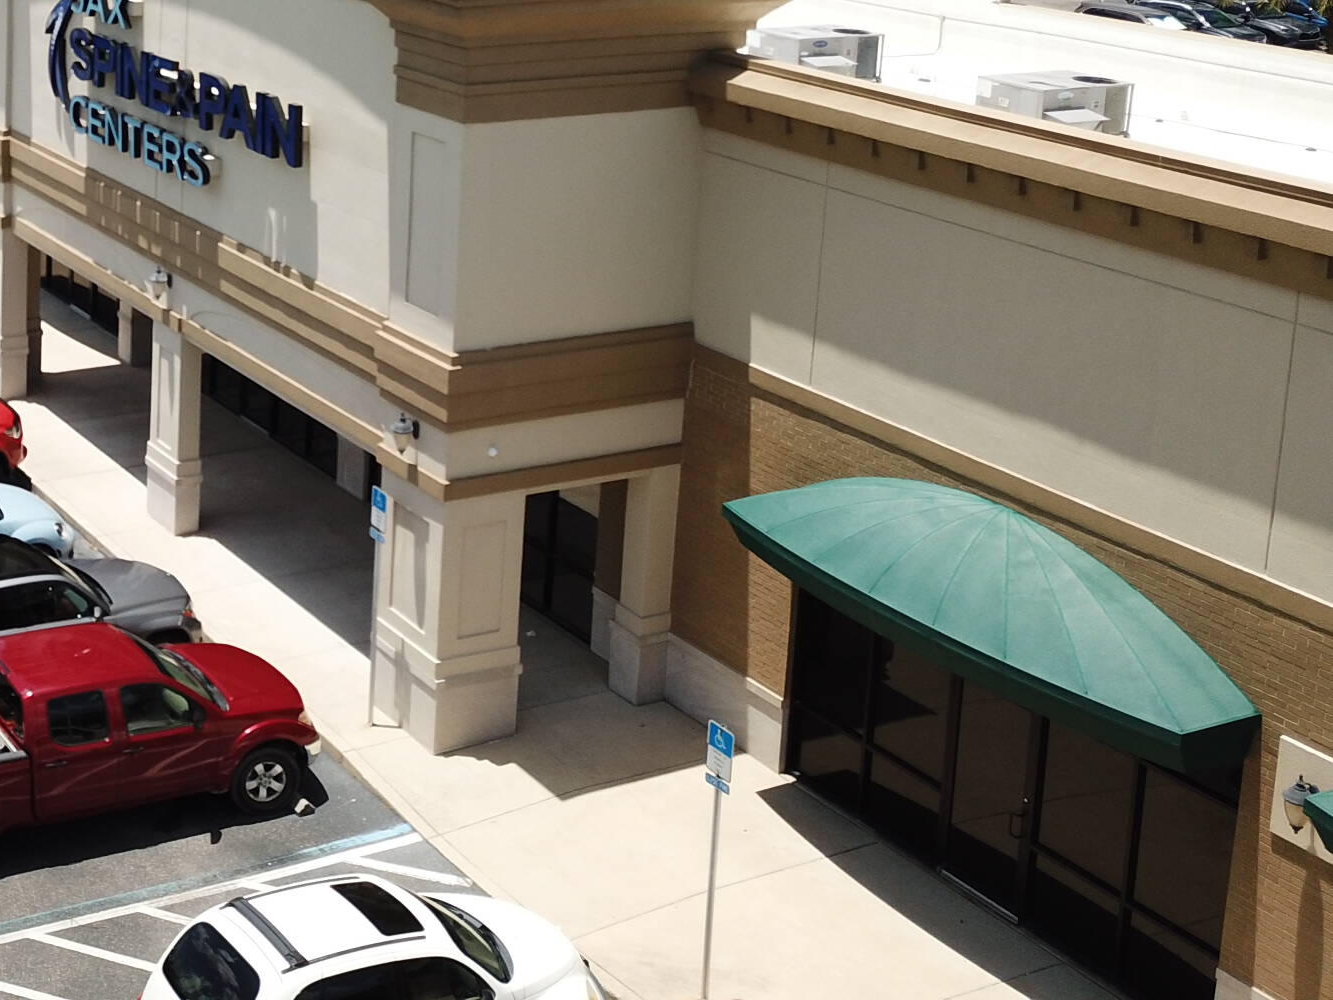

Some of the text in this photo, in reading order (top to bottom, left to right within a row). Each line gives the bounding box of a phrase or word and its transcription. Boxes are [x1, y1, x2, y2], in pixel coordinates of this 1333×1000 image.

[69, 28, 179, 117] SPINE
[199, 72, 303, 168] PAIN
[69, 96, 210, 187] CENTERS
